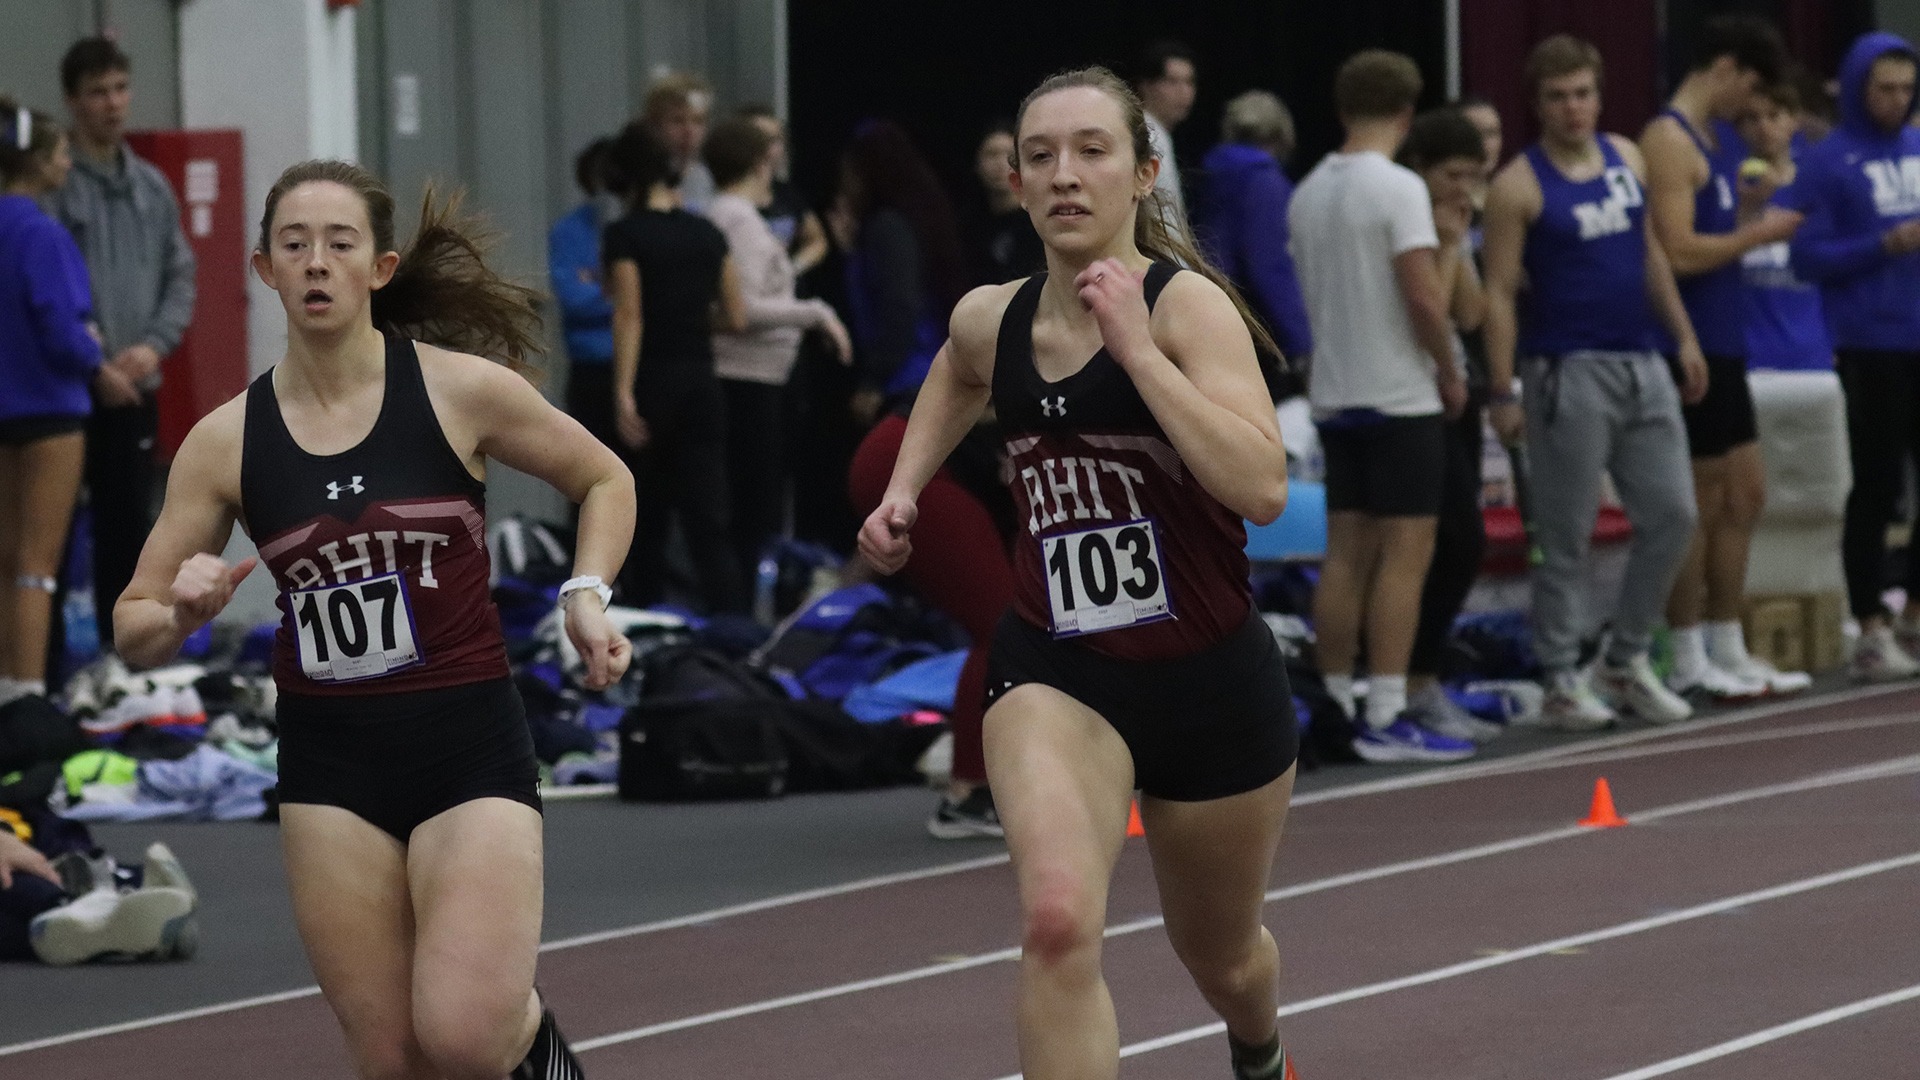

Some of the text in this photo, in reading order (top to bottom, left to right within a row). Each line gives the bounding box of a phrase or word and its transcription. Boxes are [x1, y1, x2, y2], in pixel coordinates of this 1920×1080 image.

[1021, 457, 1145, 536] RHIT
[1049, 527, 1160, 612] 103
[299, 578, 399, 662] 107
